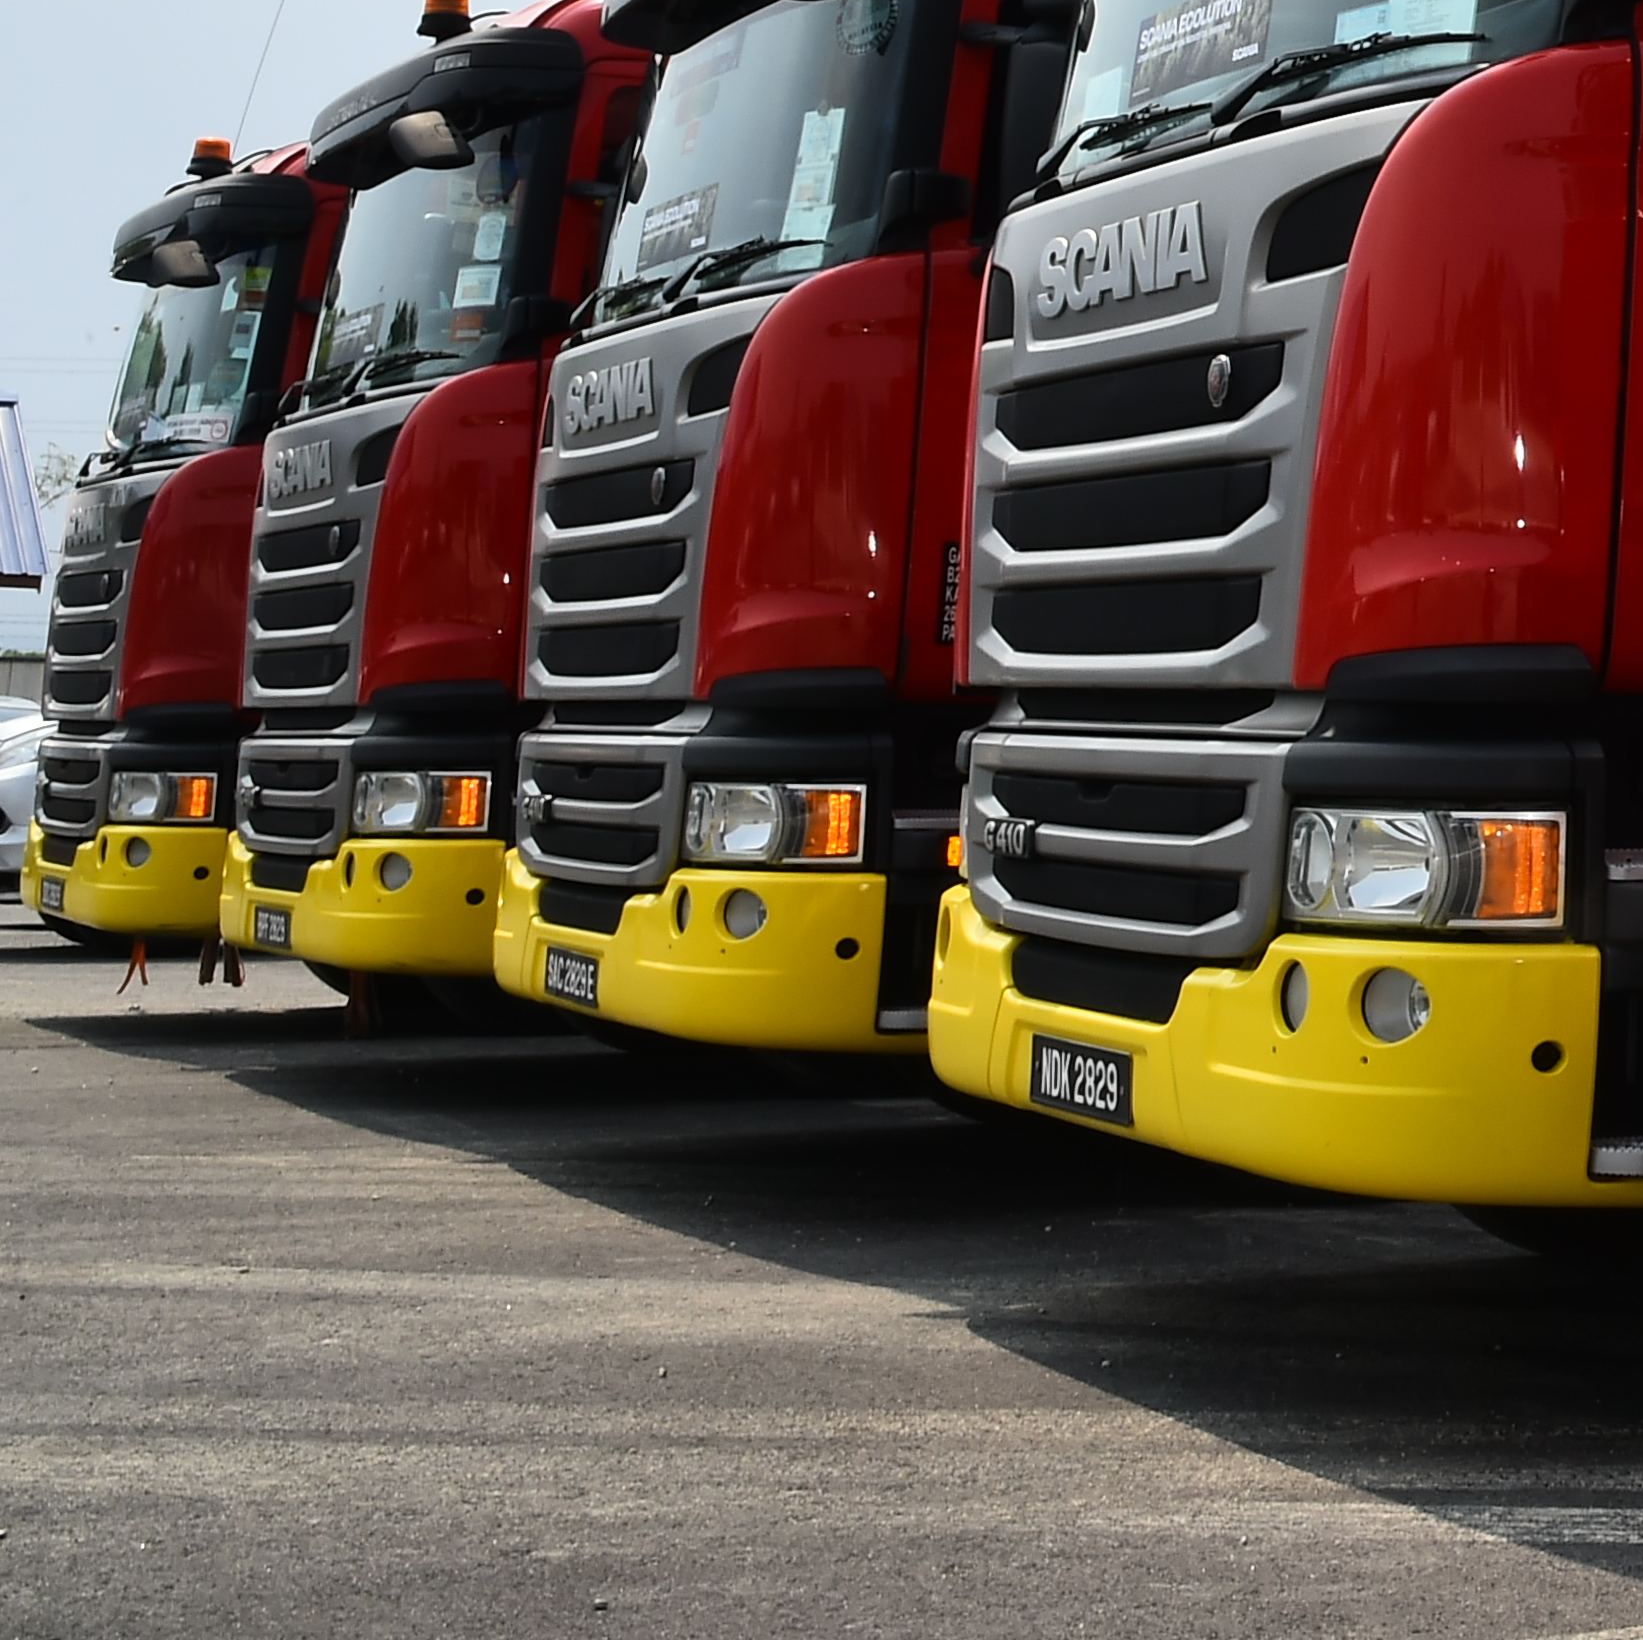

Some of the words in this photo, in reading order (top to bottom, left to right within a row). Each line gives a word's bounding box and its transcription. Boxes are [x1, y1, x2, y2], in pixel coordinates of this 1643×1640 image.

[1140, 17, 1177, 51] SCANIA
[1037, 199, 1208, 319] SCANIA
[564, 356, 655, 437] SCANIA
[269, 438, 333, 499] SCANIA
[984, 820, 996, 851] G
[996, 822, 1025, 855] 410
[1040, 1046, 1071, 1101] NDK
[1074, 1055, 1118, 1111] 2829
